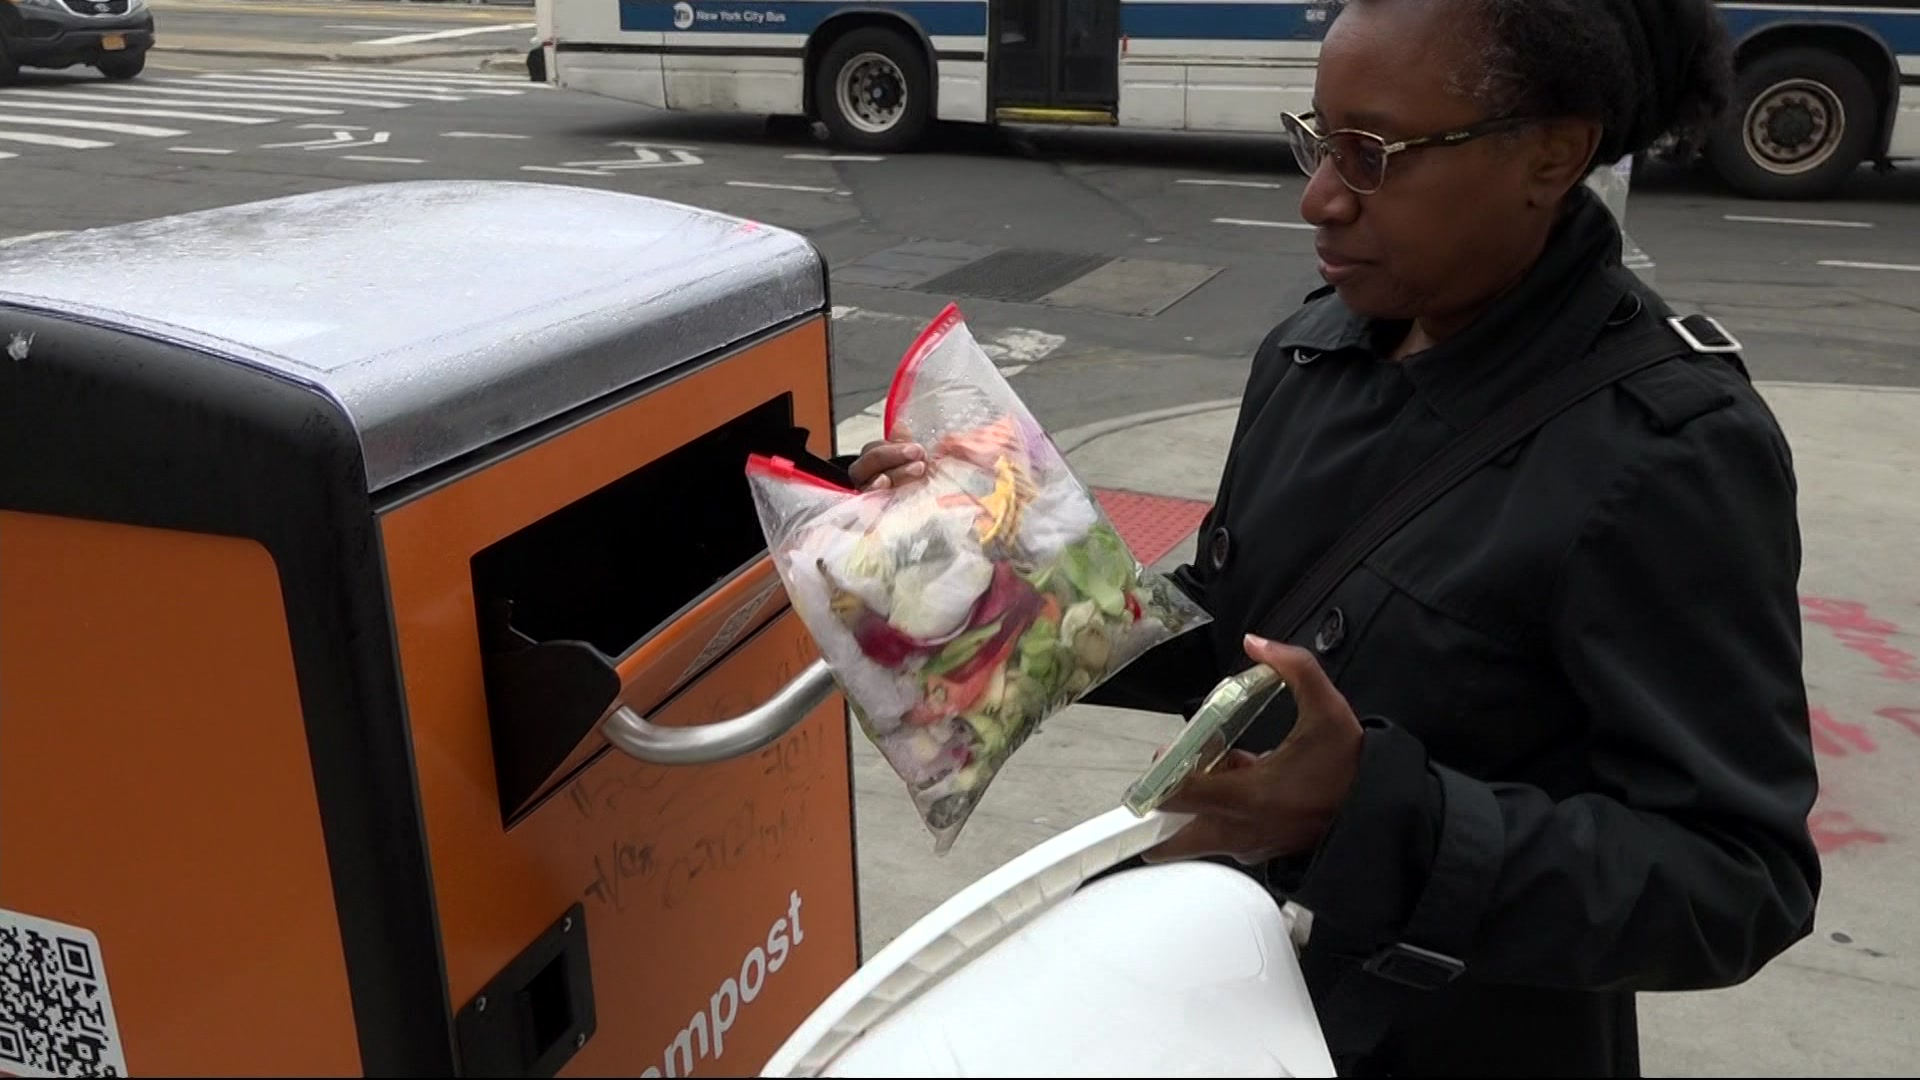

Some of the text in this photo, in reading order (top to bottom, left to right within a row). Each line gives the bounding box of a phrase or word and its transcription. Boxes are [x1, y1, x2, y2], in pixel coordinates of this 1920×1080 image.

[696, 10, 718, 21] New
[720, 11, 742, 22] York
[743, 11, 765, 24] City
[766, 12, 787, 22] Bus
[640, 889, 804, 1078] mpost
